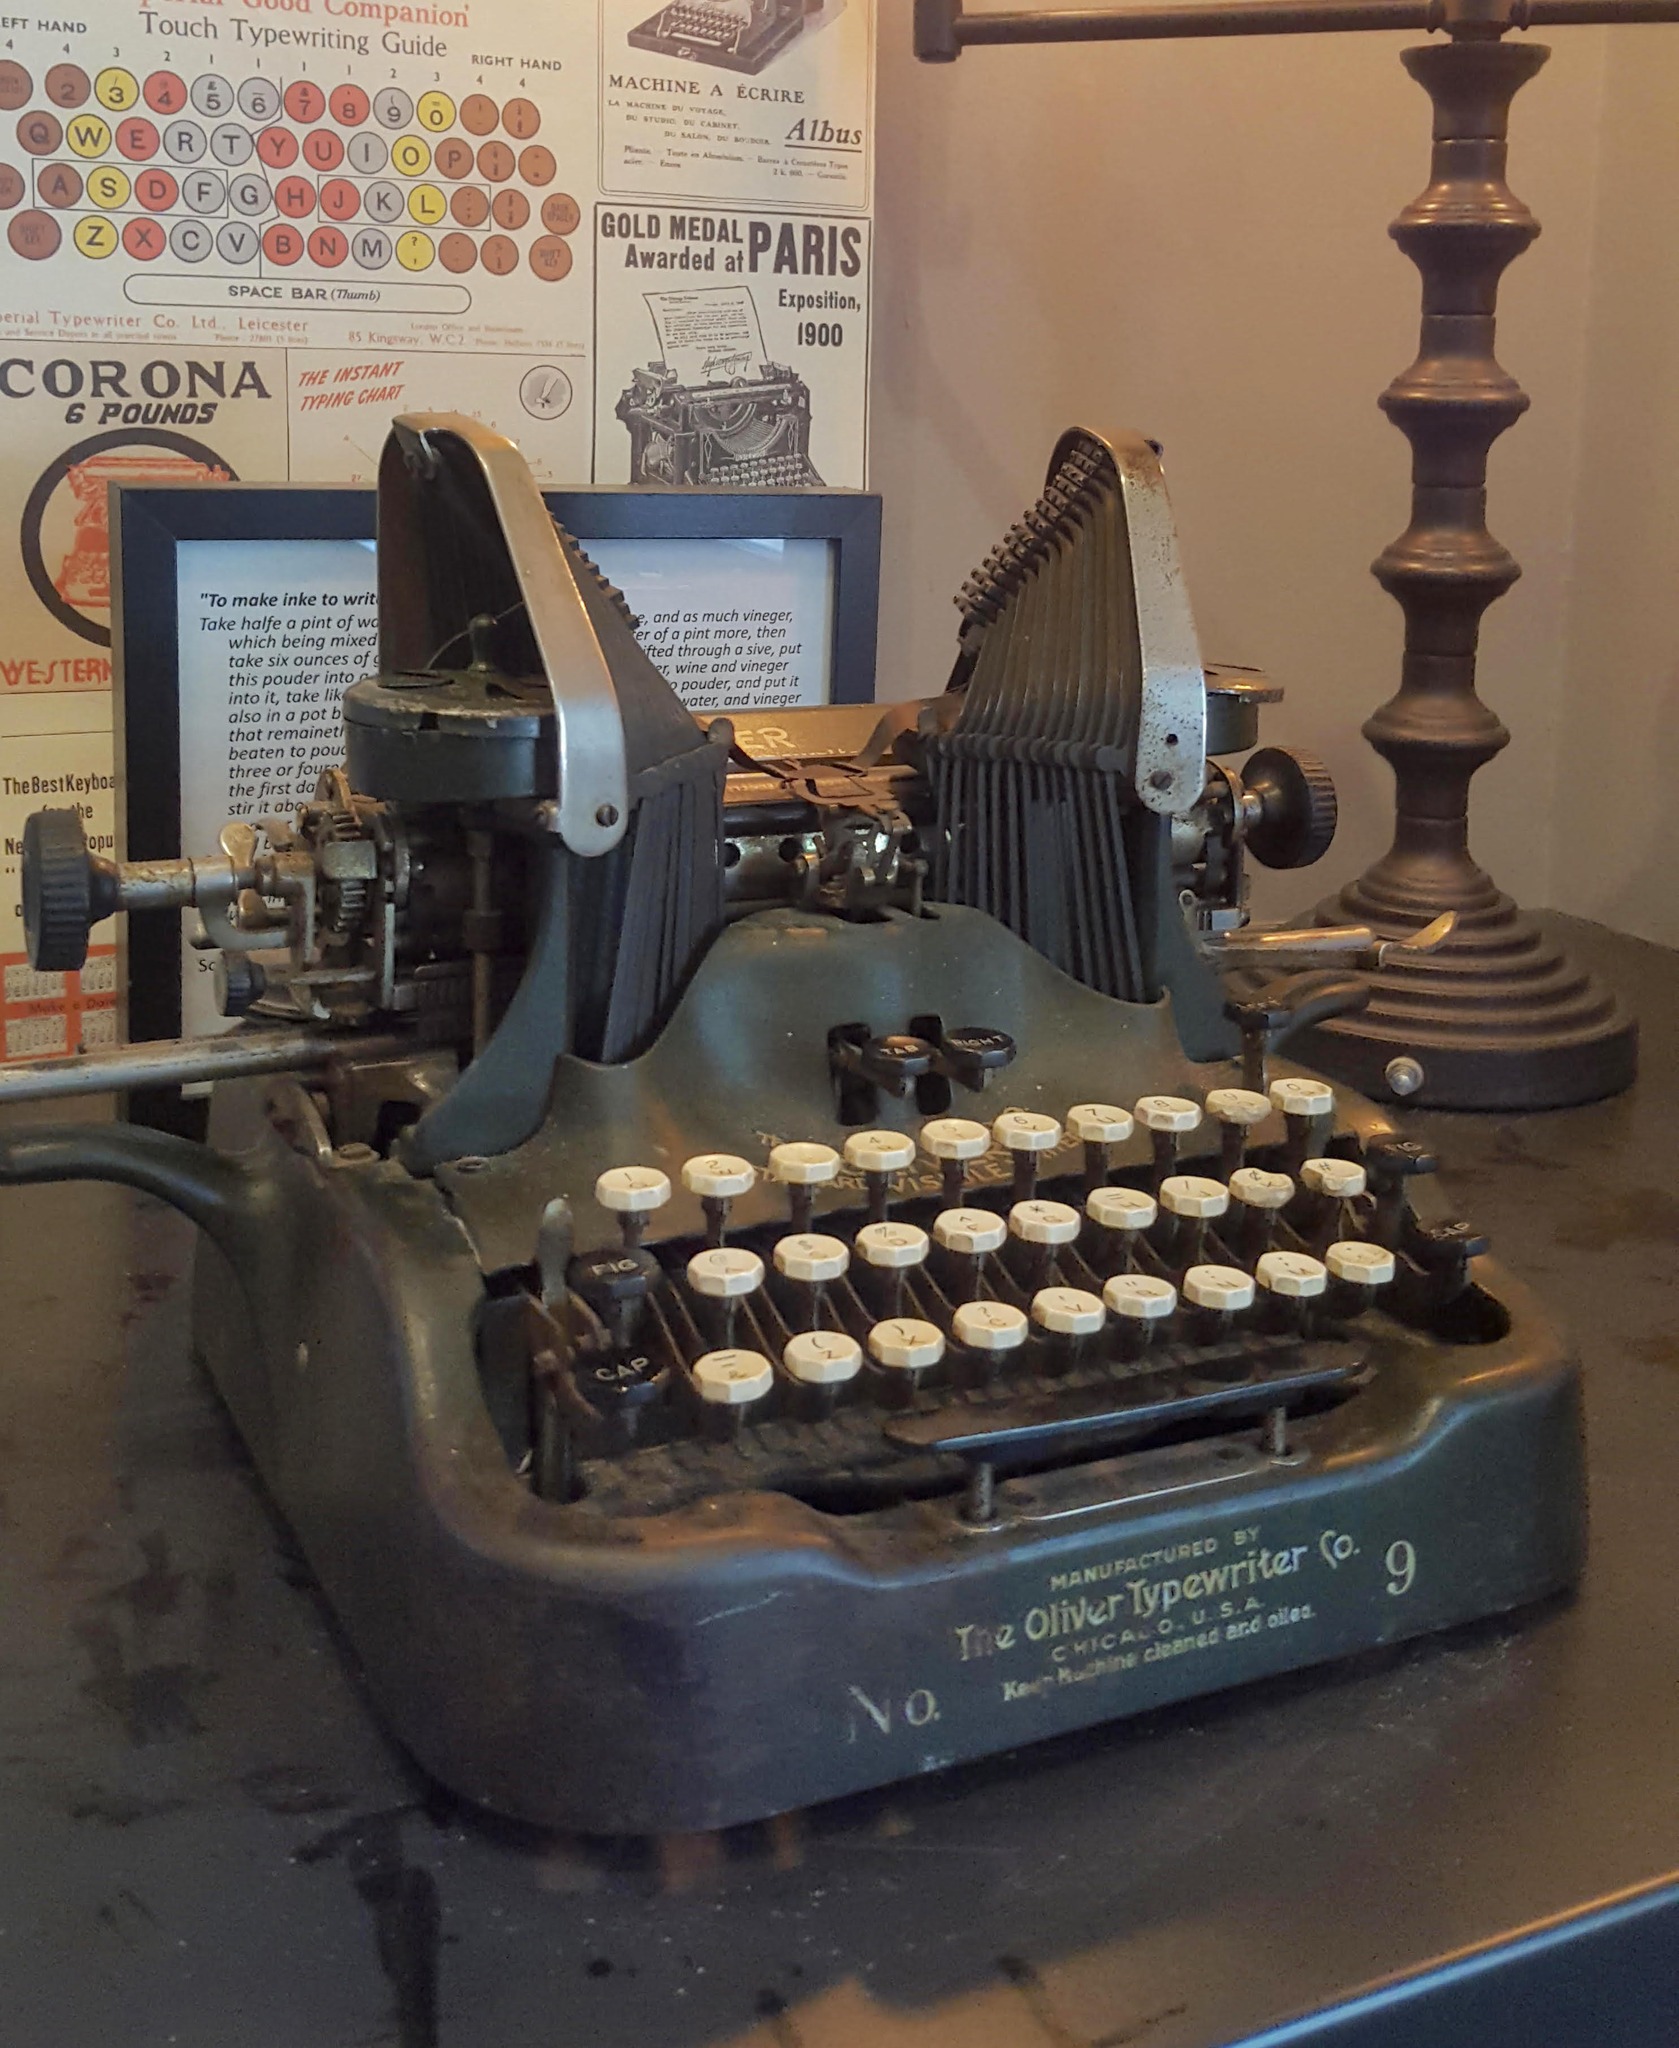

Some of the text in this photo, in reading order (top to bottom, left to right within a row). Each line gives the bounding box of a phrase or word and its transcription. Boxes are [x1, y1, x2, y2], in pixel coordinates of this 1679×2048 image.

[0, 17, 87, 34] EFT HAND
[139, 11, 447, 57] Touch Typewriting Guide
[471, 54, 562, 71] RIGHT HAND
[609, 74, 805, 104] MACHINE A ÉCRIRE
[785, 117, 862, 145] Albus
[601, 211, 661, 240] GOLD
[669, 215, 743, 244] MEDAL
[624, 243, 744, 273] Awarded at
[749, 220, 862, 277] PARIS
[228, 284, 381, 303] SPACE BAR (Thumb)
[778, 288, 861, 313] Exposition,
[48, 310, 141, 328] Typewriter
[239, 317, 308, 332] Leicester
[797, 322, 843, 347] 1900
[0, 358, 272, 399] CORONA
[298, 360, 404, 388] THE INSTANT
[300, 384, 405, 412] TYPING CHART
[65, 402, 218, 425] 6 POUNDS
[200, 592, 227, 607] "To
[232, 592, 278, 607] make
[282, 592, 317, 607] inke
[322, 593, 338, 607] to
[200, 617, 236, 631] Take
[241, 615, 281, 633] halfe
[287, 619, 296, 629] a
[300, 616, 333, 632] pint
[337, 614, 355, 631] of
[653, 610, 680, 624] and
[683, 612, 698, 623] as
[702, 609, 739, 623] much
[743, 609, 793, 625] vineger,
[229, 633, 378, 650] which being mixed
[653, 627, 670, 643] of
[672, 629, 680, 640] a
[683, 626, 710, 642] pint
[714, 628, 752, 641] more,
[757, 626, 786, 639] then
[229, 651, 371, 668] take six ounces of
[678, 643, 802, 660] through a sive, put
[0, 658, 112, 686] WESTERN
[675, 660, 789, 675] wine and vineger
[229, 671, 355, 689] this pouder into
[681, 675, 799, 692] pouder, and put it
[228, 690, 319, 706] into it, take
[723, 693, 750, 706] and
[753, 692, 802, 707] vineger
[229, 708, 327, 724] also in a pot
[229, 728, 262, 742] that
[229, 746, 305, 760] beaten to
[229, 765, 293, 779] three or
[3, 778, 30, 795] The
[32, 776, 64, 793] Best
[229, 782, 291, 799] the first
[228, 801, 270, 816] stir it
[592, 1258, 639, 1276] FIG
[595, 1357, 649, 1382] CAP
[1051, 1526, 1262, 1591] MANUFACTURED BY
[1385, 1540, 1417, 1596] 9
[1025, 1594, 1125, 1641] Oliver
[1126, 1545, 1308, 1618] Typewriter
[1319, 1529, 1361, 1569] Co.
[1226, 1617, 1262, 1641] and
